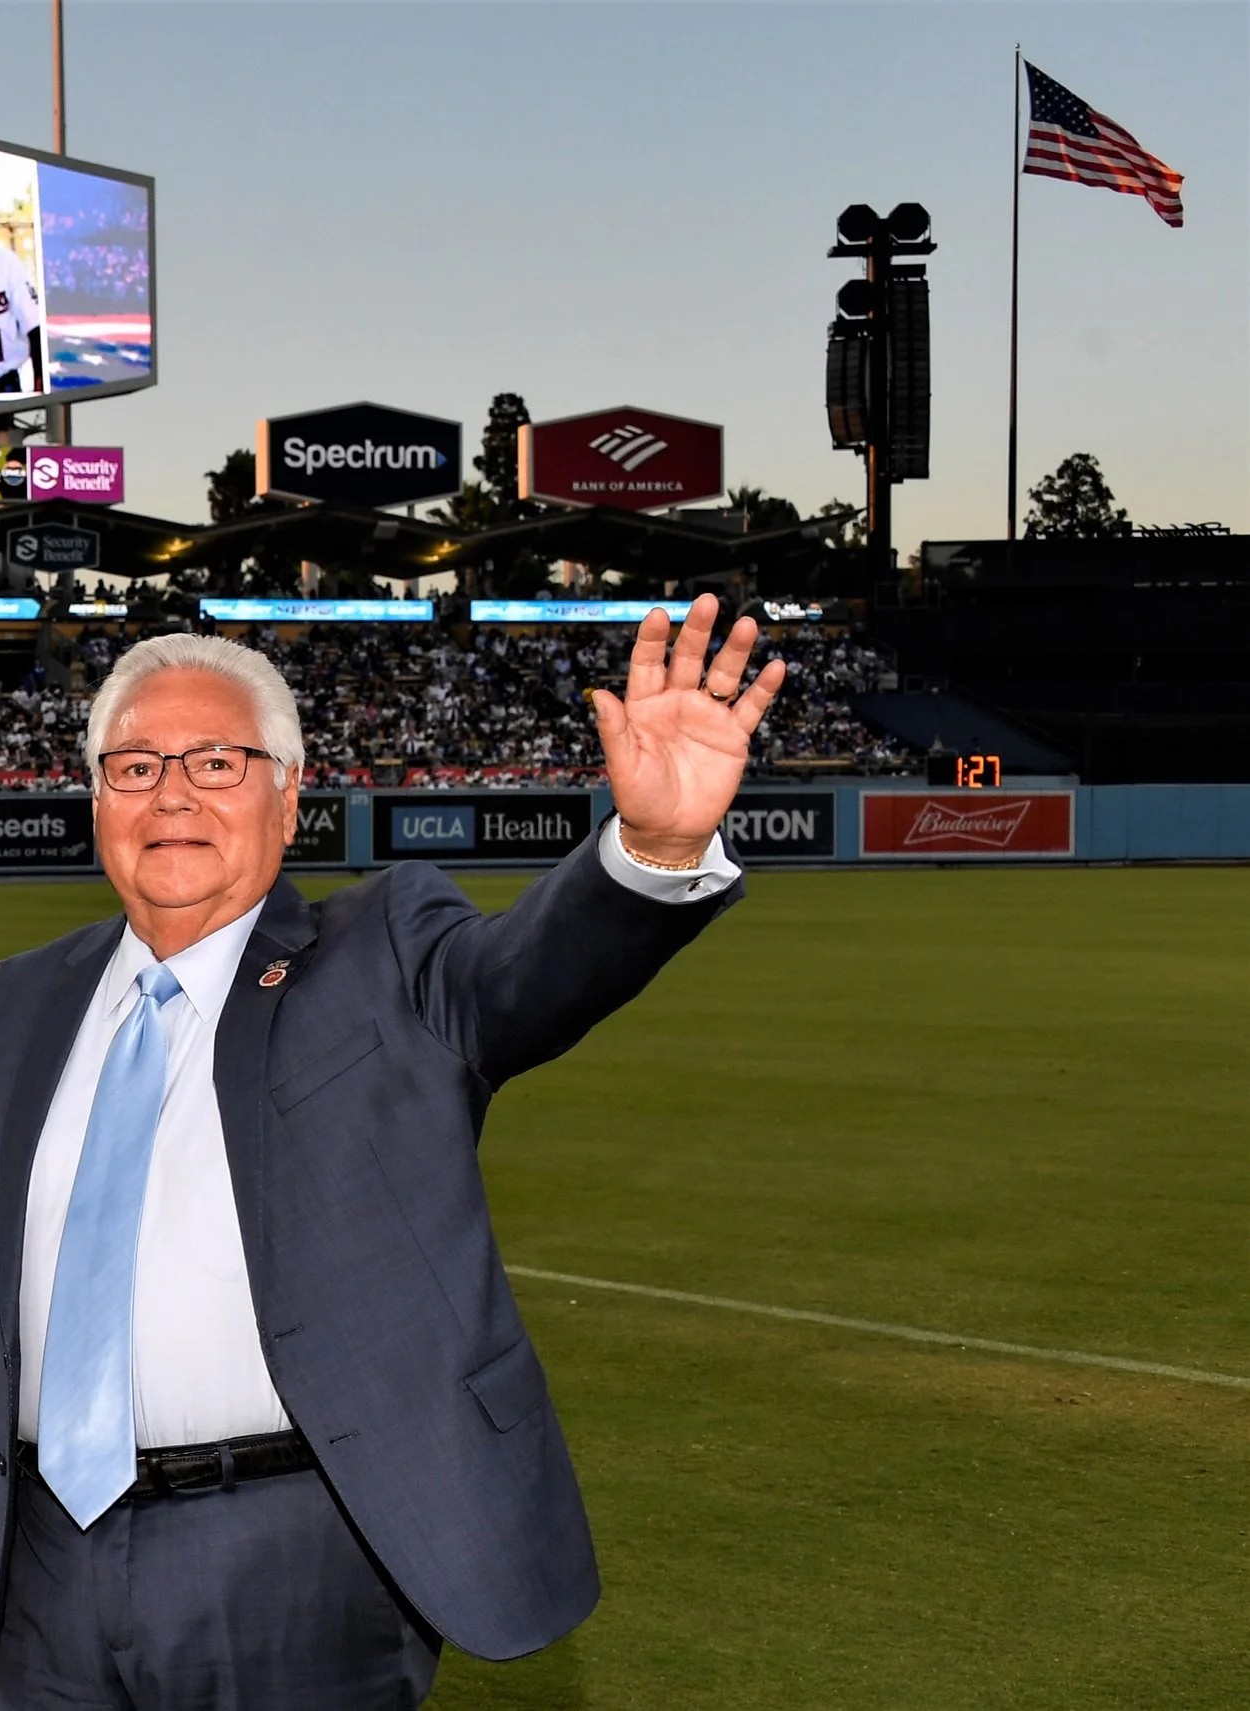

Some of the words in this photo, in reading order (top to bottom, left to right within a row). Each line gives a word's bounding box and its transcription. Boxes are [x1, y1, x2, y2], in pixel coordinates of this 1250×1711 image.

[284, 437, 437, 475] Spectrum
[63, 458, 118, 482] Security
[64, 475, 112, 491] Benefit
[572, 481, 606, 491] BANK
[609, 481, 624, 491] OF
[628, 481, 683, 491] AMERICA
[43, 535, 89, 555] Security
[43, 549, 84, 562] Benefit
[957, 755, 1000, 788] 1:27
[403, 816, 464, 838] UCLA
[483, 813, 573, 840] Health
[726, 809, 815, 840] RTON
[916, 809, 1018, 833] Budweiser
[24, 848, 37, 857] OF
[40, 847, 58, 857] THE
